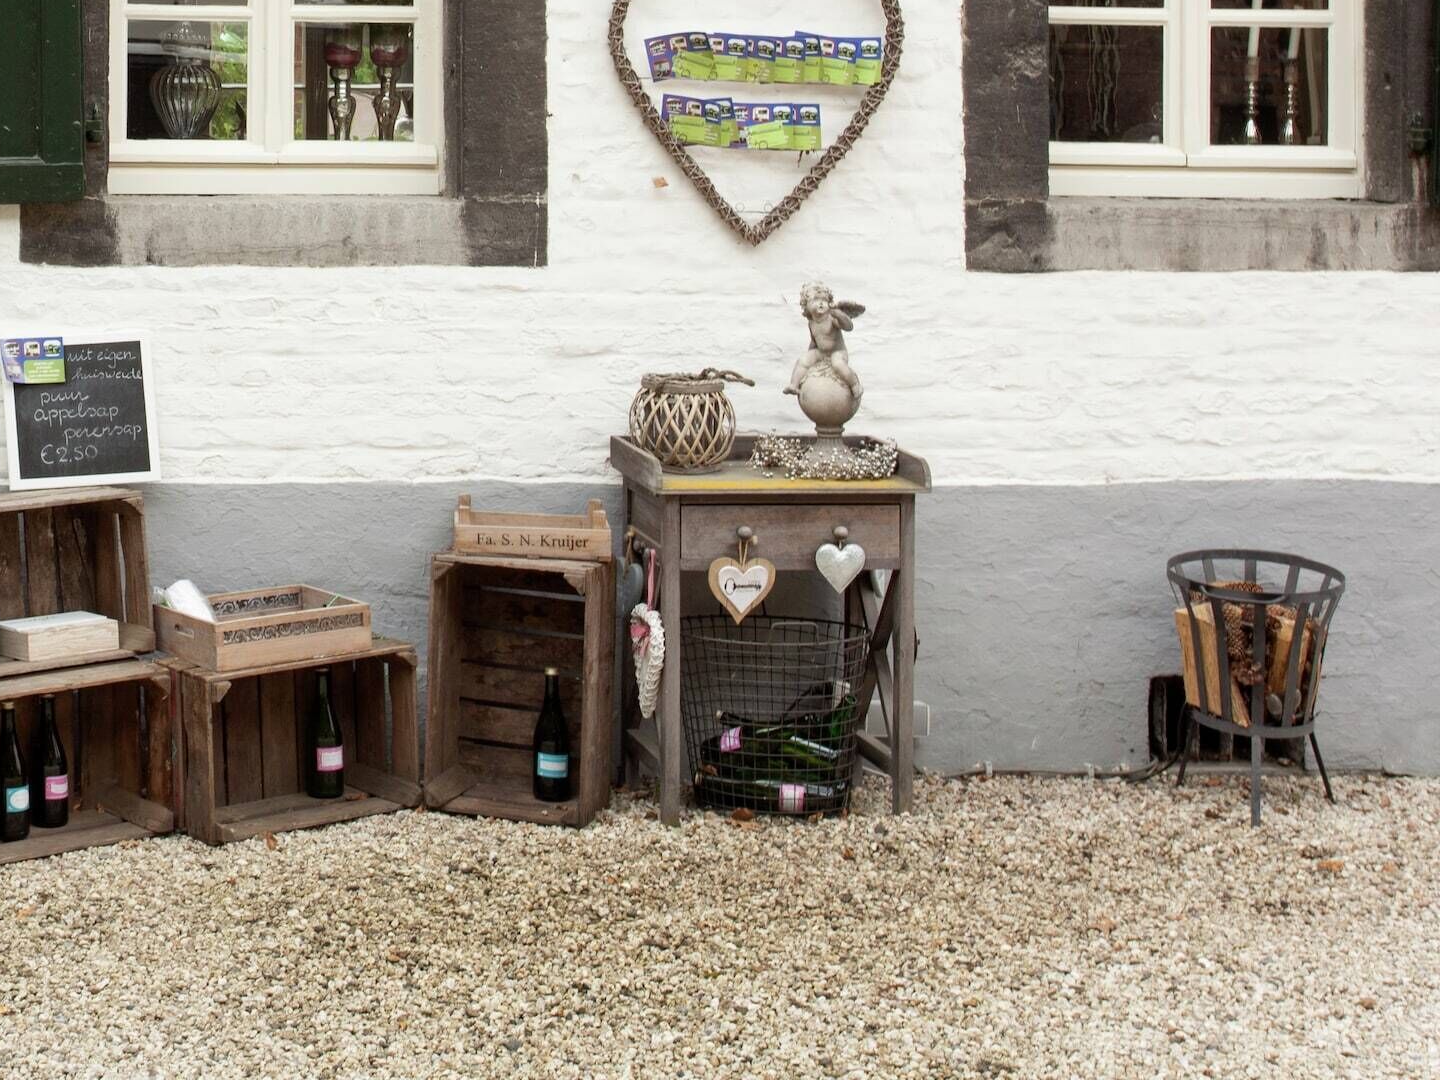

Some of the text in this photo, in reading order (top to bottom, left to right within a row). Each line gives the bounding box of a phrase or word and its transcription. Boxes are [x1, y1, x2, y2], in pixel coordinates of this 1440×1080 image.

[67, 347, 136, 369] uit eigen
[40, 391, 90, 406] puur
[33, 402, 119, 428] appelsap
[63, 424, 142, 446] perensap
[477, 532, 589, 551] Fa. S. N. Kruijer
